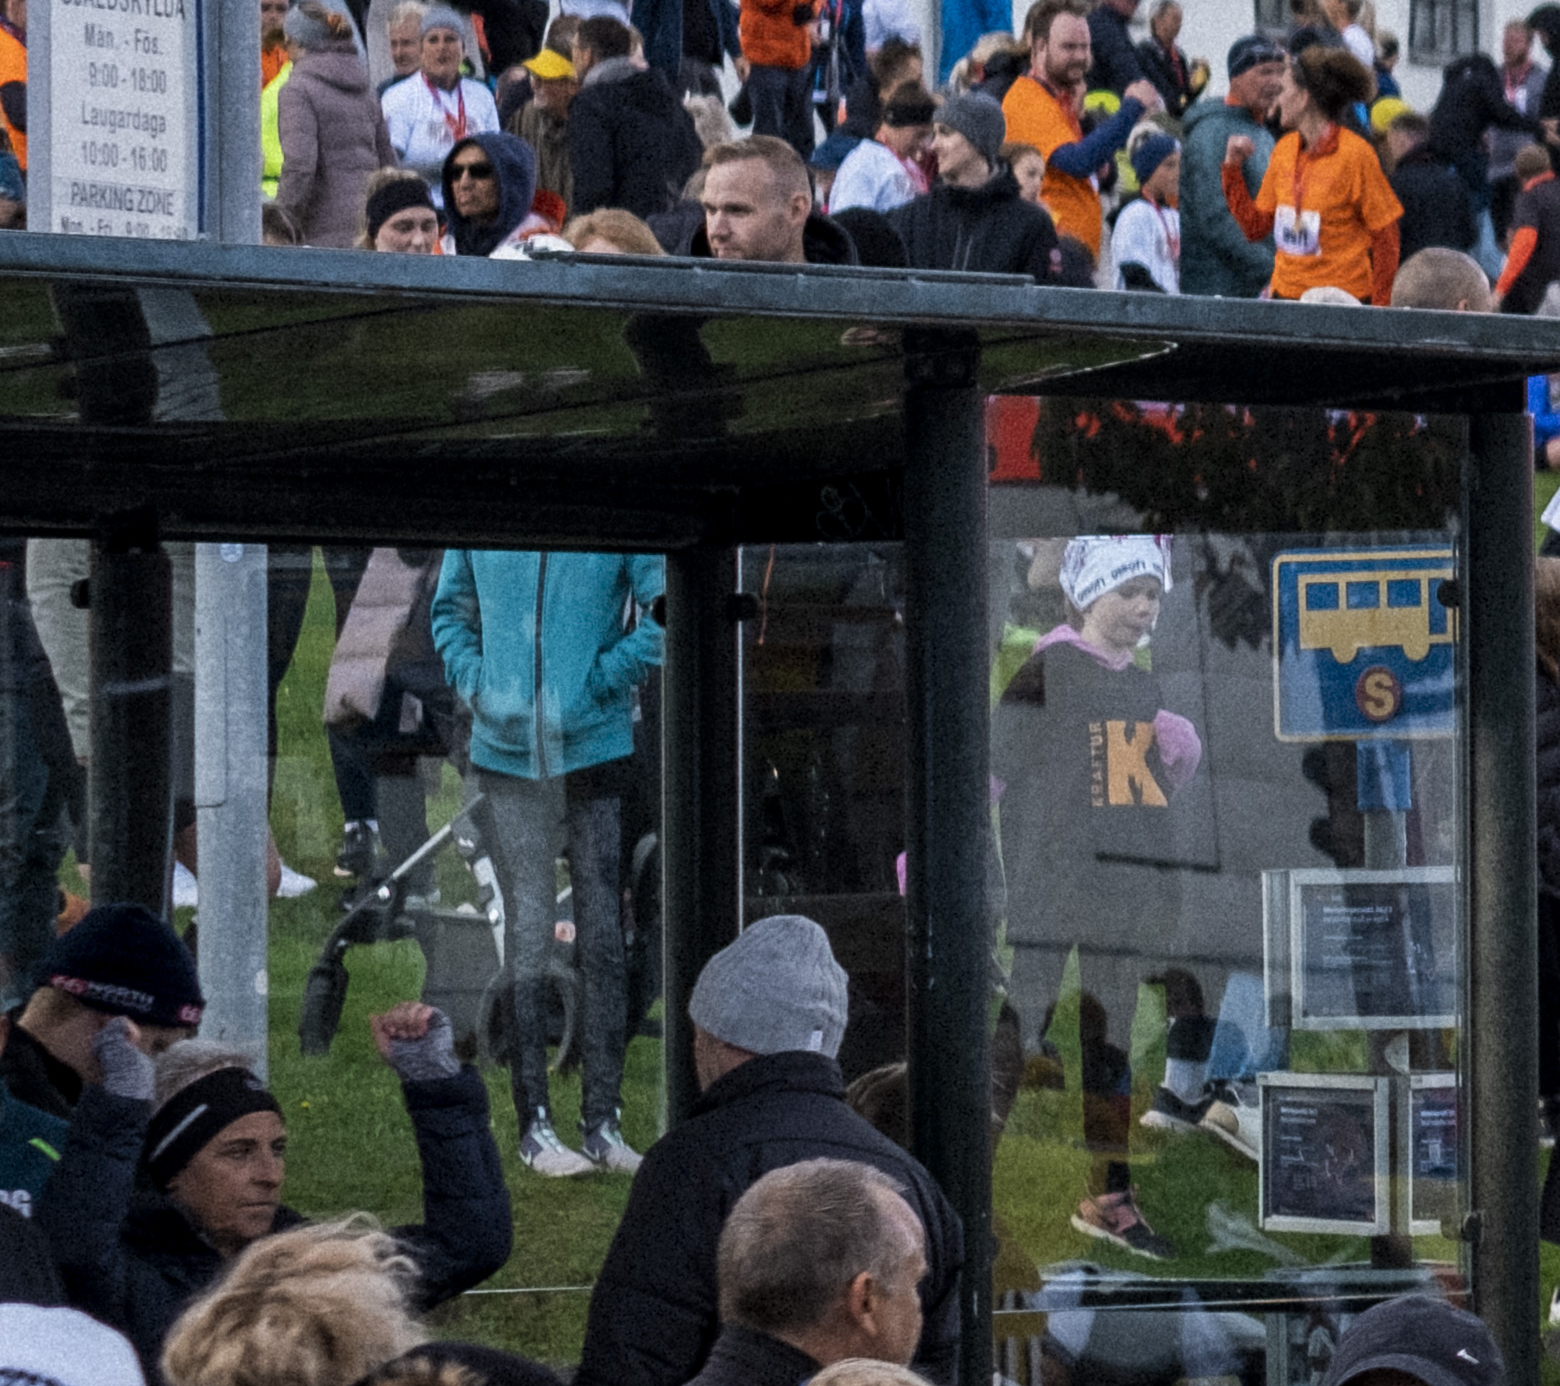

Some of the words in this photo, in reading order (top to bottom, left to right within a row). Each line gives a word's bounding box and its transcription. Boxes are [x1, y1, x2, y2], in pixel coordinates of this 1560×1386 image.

[80, 100, 167, 139] Laugardaga
[80, 140, 119, 168] 10:00
[70, 180, 133, 212] PARKING
[136, 188, 175, 217] ZONE
[1363, 672, 1395, 718] S
[1088, 722, 1105, 808] KRAFTUR
[1106, 720, 1168, 807] K
